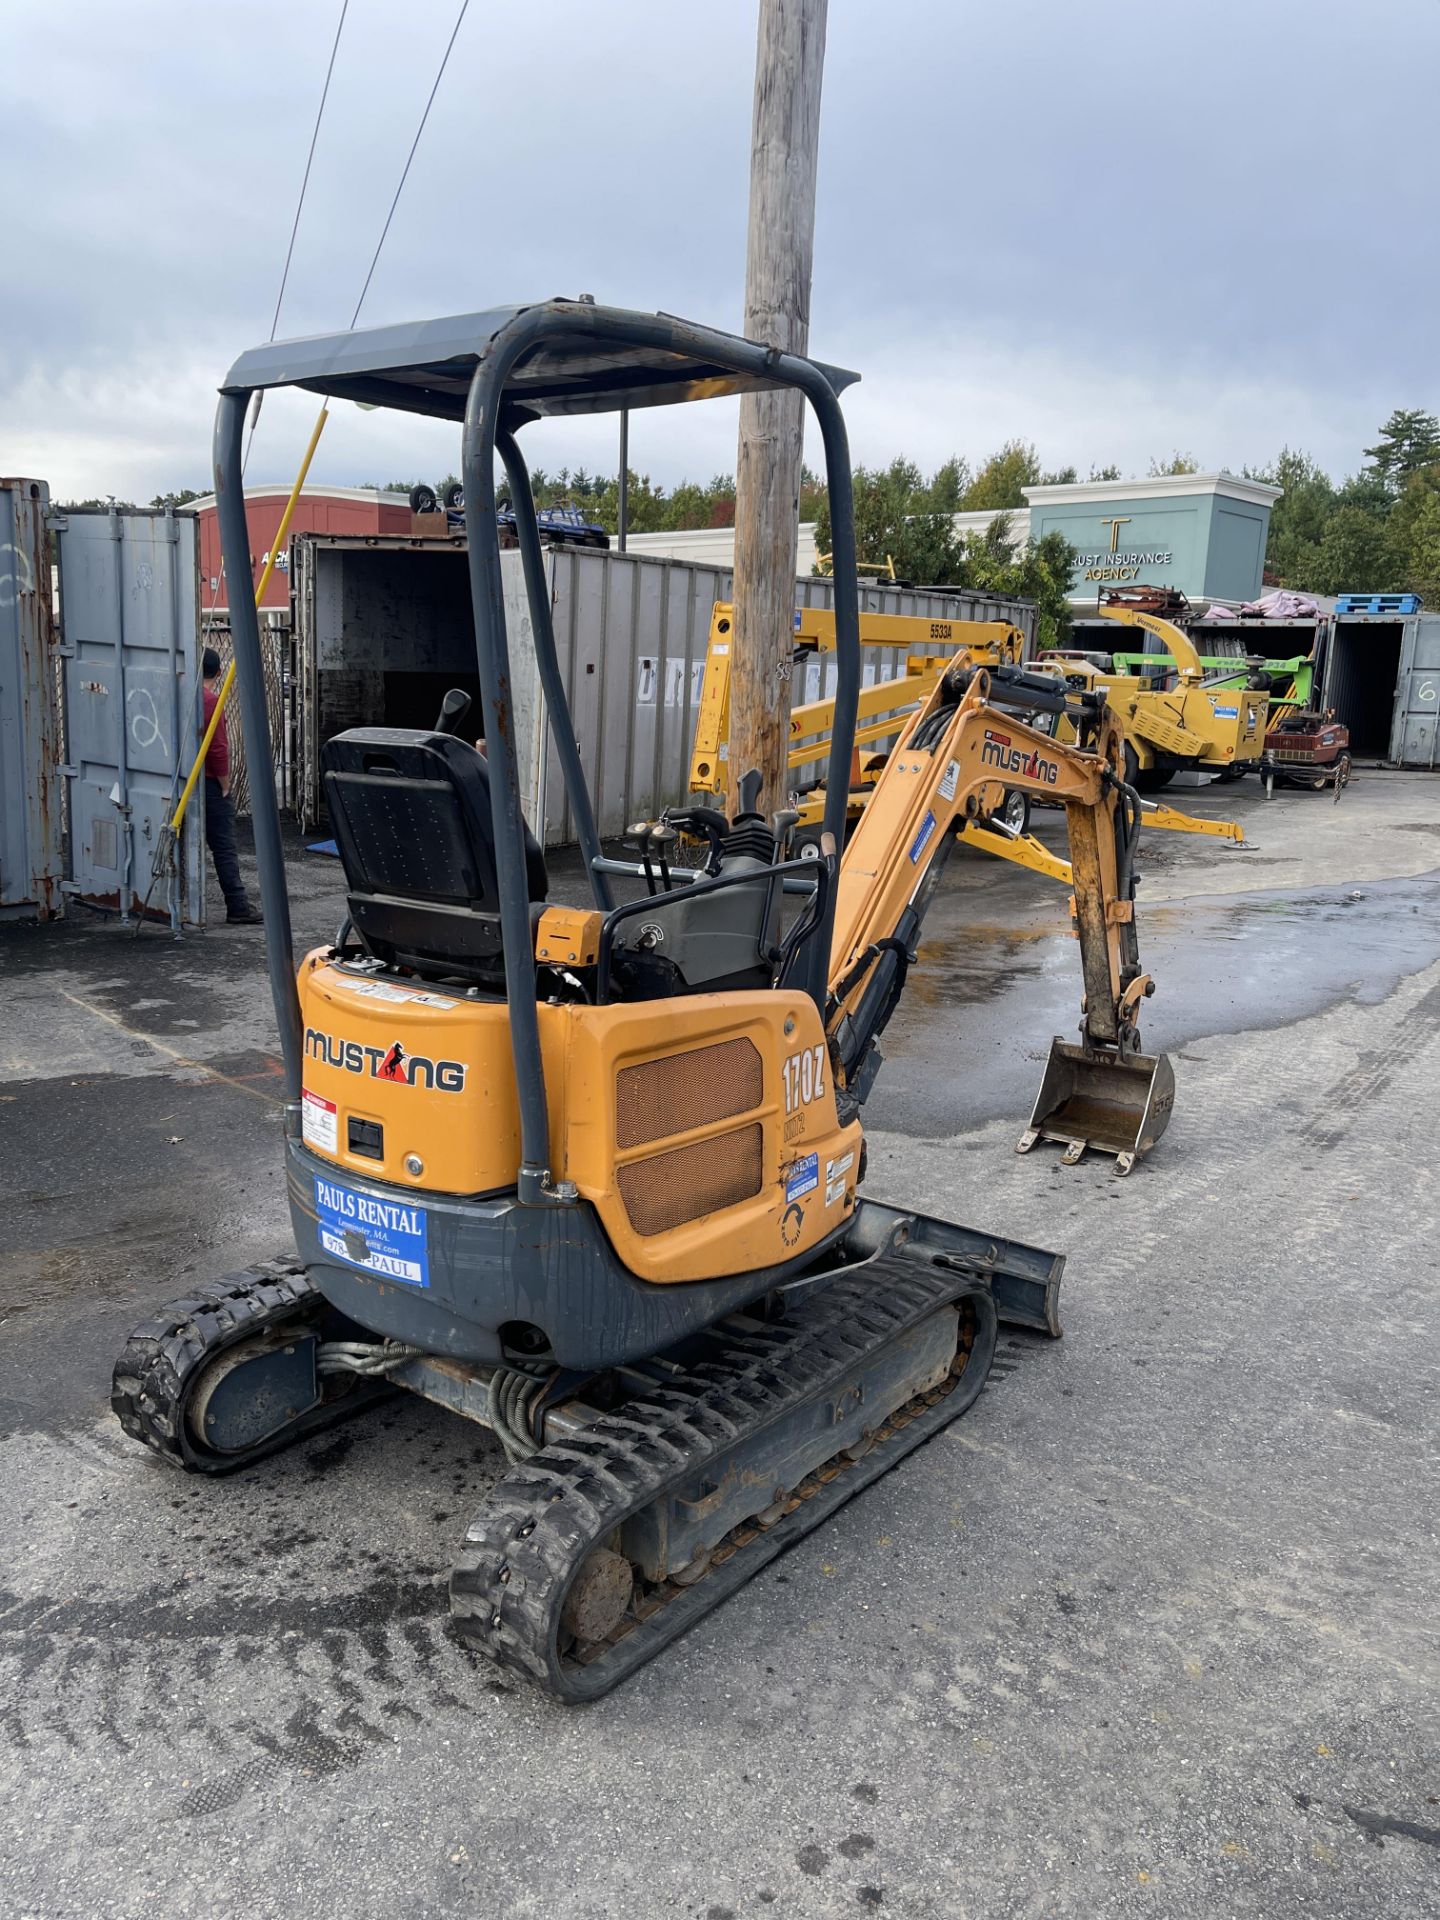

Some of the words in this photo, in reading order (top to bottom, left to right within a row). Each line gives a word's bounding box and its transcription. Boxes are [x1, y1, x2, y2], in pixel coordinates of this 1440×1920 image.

[1072, 554, 1100, 566] RUST
[1104, 552, 1172, 564] INSURANCE
[1084, 566, 1140, 580] AGENCY
[930, 624, 952, 639] 5533A
[1136, 616, 1162, 633] Vermeer
[1418, 680, 1436, 701] 6
[981, 742, 1058, 785] MUSTANG
[305, 1028, 465, 1093] MUSTANG
[782, 1043, 825, 1116] 170Z
[317, 1181, 355, 1217] PAULS
[357, 1198, 422, 1236] RENTAL
[326, 1236, 412, 1278] 978--PAUL
